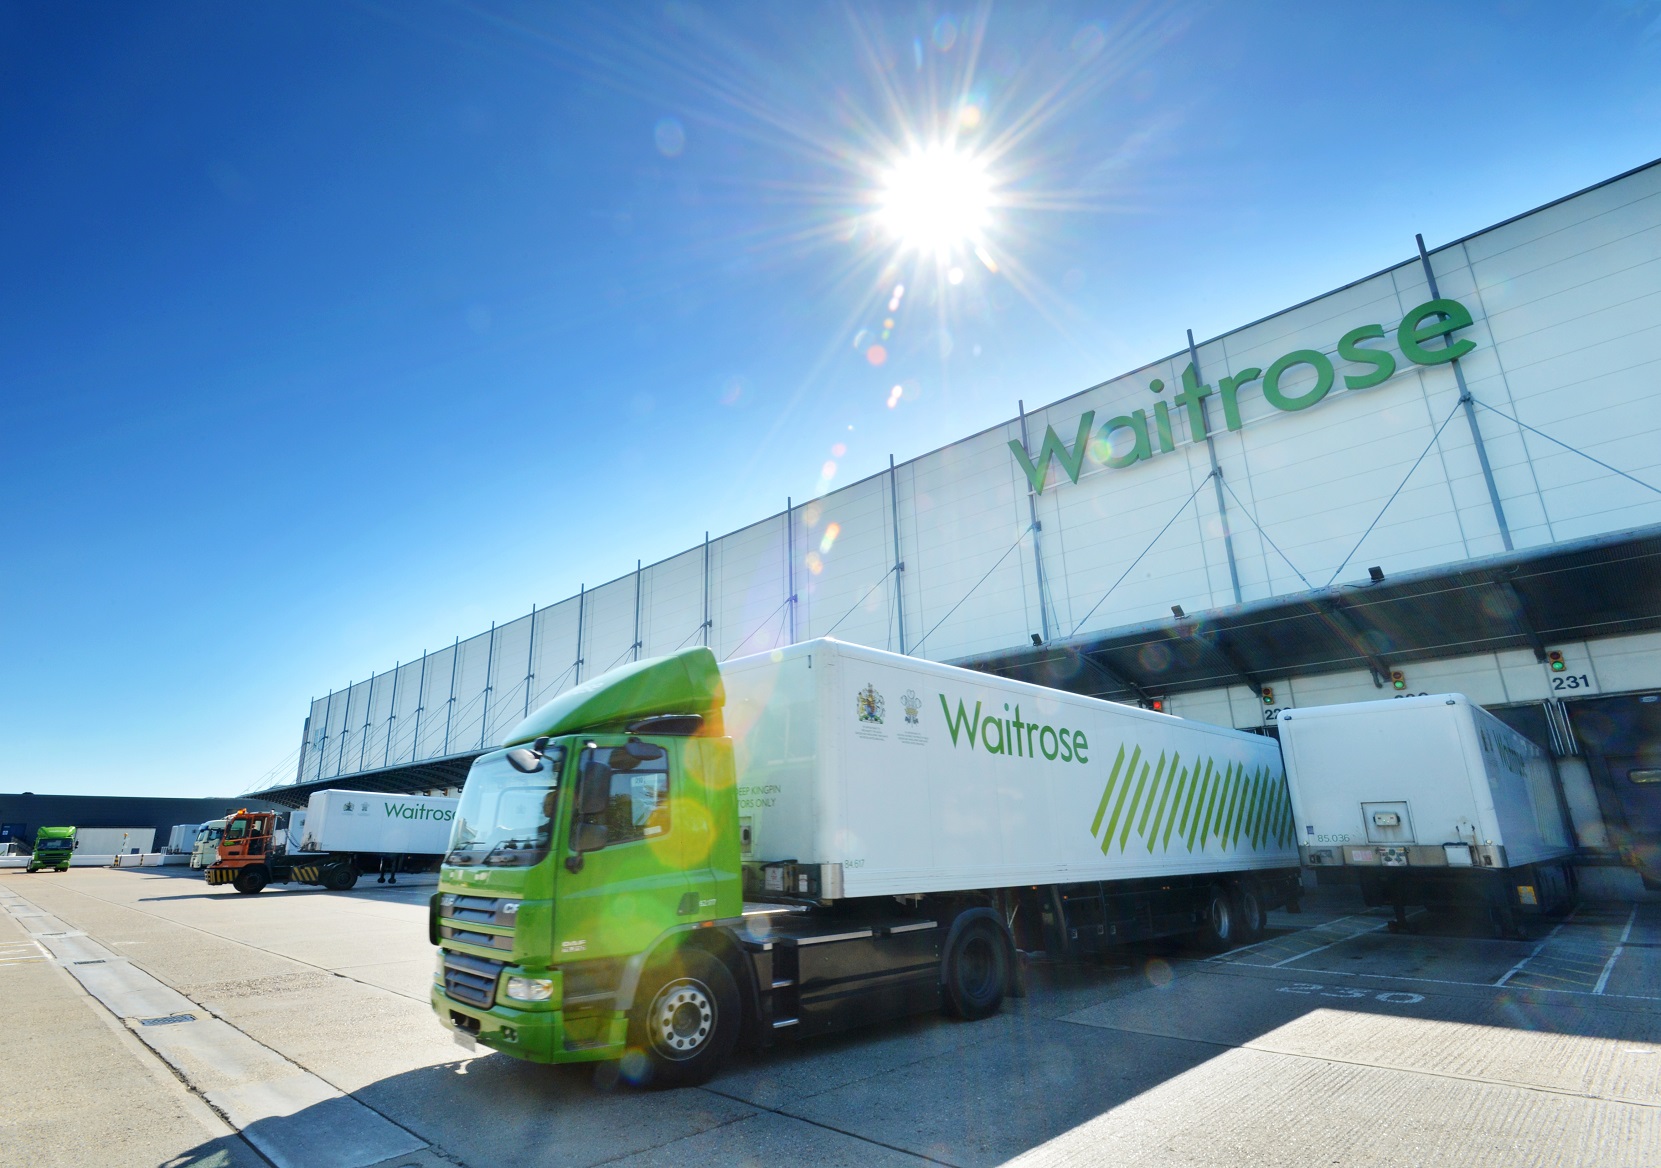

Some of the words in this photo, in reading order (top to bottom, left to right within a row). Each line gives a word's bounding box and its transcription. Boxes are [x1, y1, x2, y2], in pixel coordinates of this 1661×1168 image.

[1007, 298, 1477, 496] Waitrose
[1552, 674, 1590, 690] 231
[939, 693, 1089, 764] Waitrose
[755, 797, 776, 808] ONLY
[1317, 833, 1350, 843] 85.036
[1275, 983, 1425, 1003] 230
